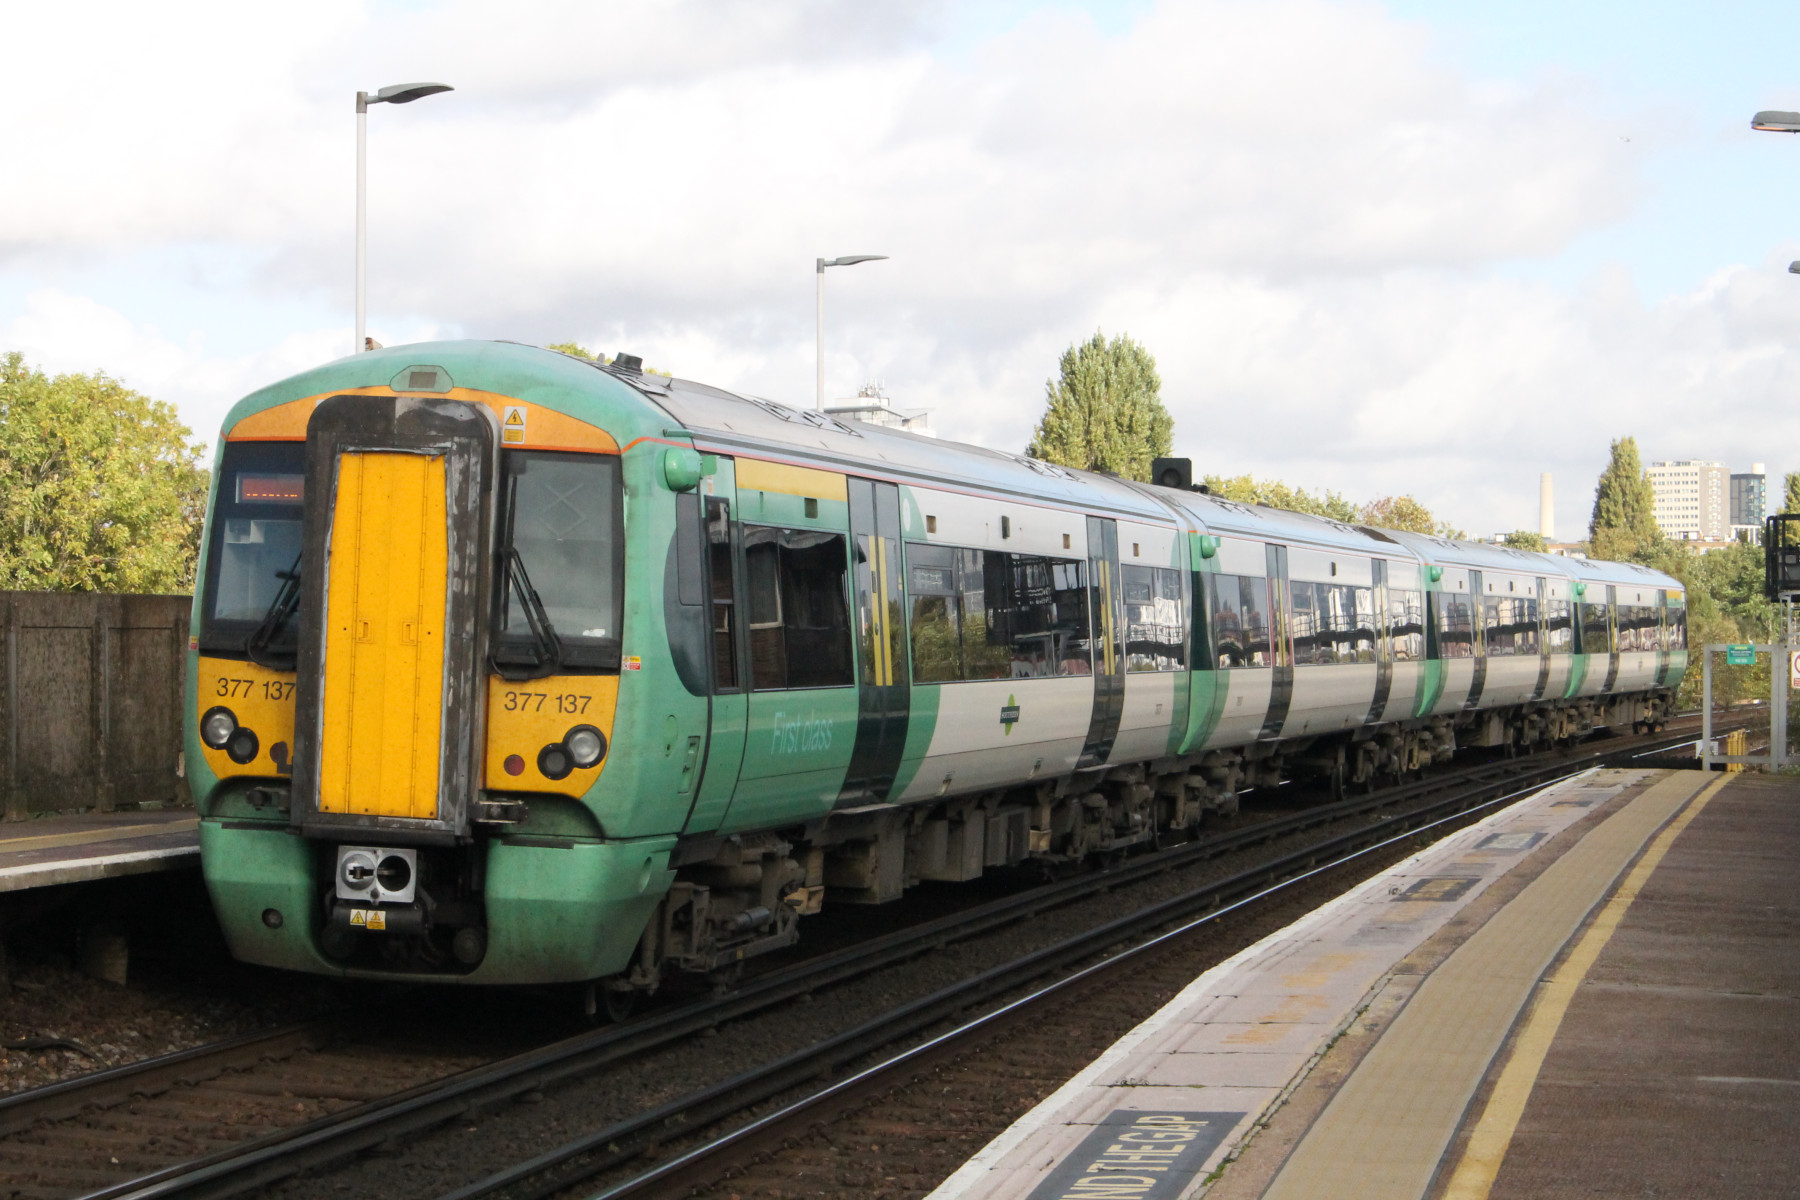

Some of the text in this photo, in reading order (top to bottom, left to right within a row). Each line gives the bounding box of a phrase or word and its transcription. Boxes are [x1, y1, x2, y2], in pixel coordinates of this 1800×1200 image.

[216, 677, 296, 701] 377 137
[504, 691, 592, 714] 377 137
[771, 709, 833, 754] First class
[1058, 1116, 1209, 1200] ND THE GAP
